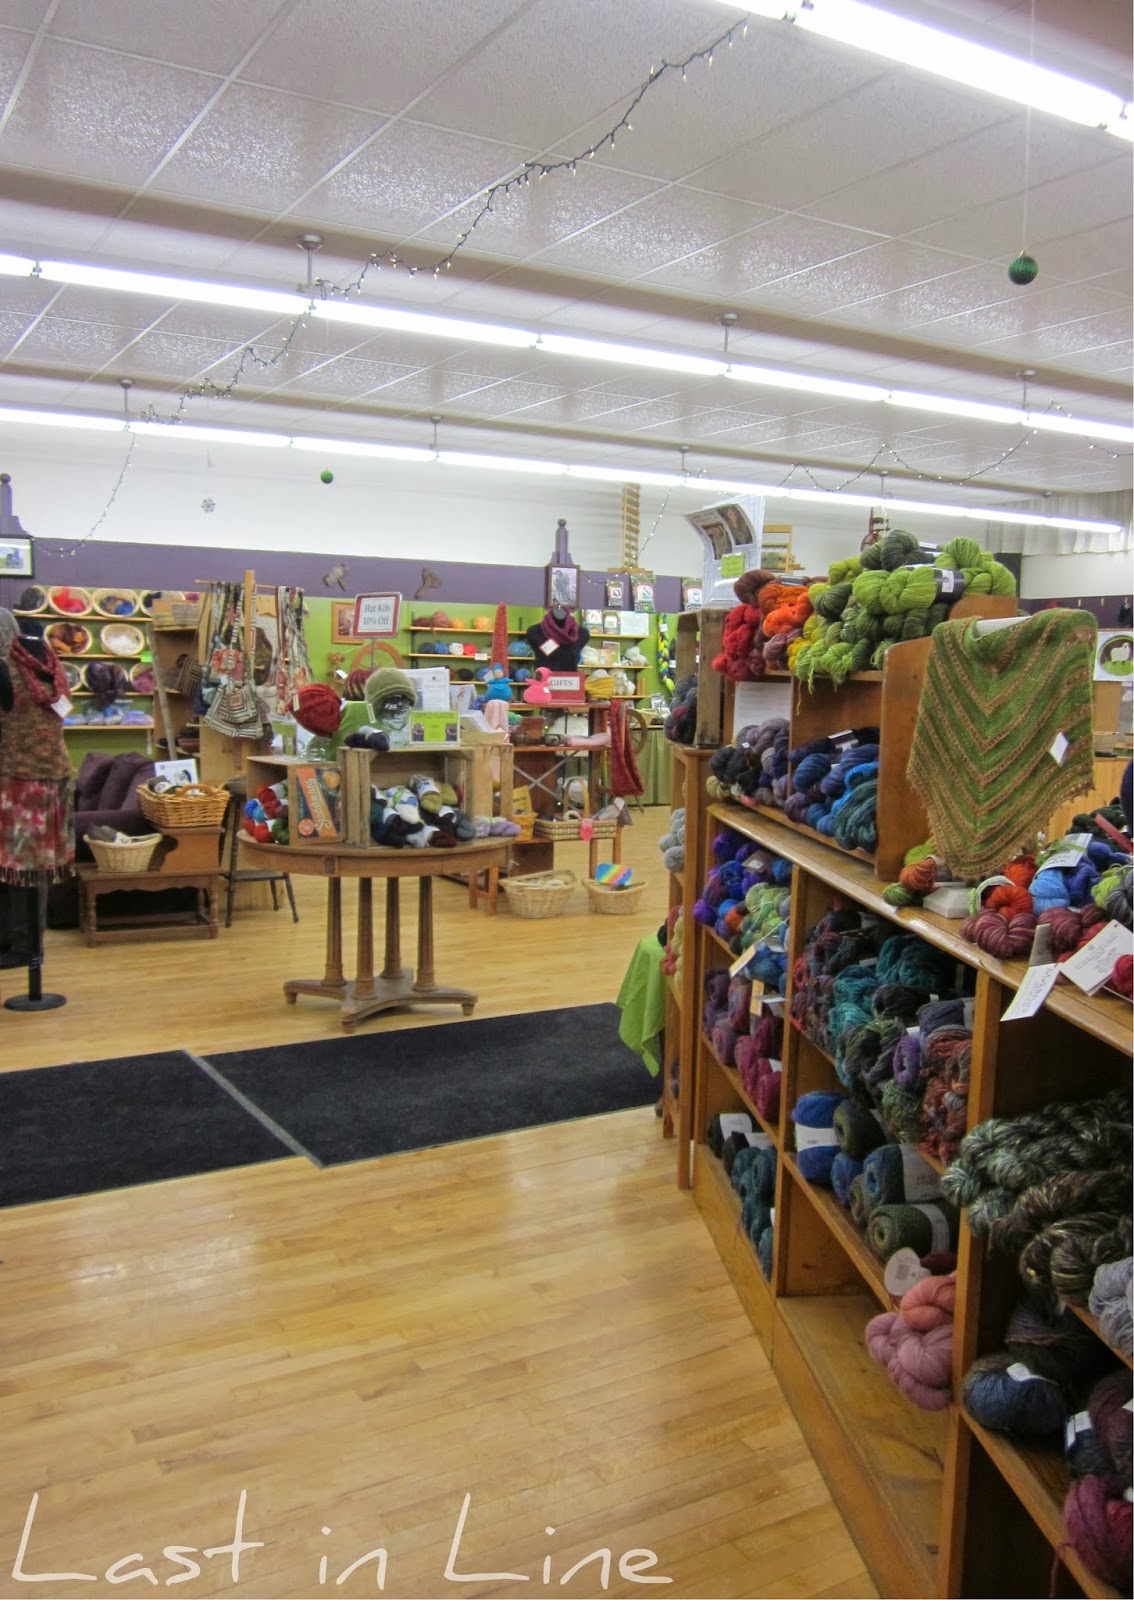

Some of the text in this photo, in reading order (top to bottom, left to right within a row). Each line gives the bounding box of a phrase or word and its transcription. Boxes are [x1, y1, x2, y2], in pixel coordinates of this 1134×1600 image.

[364, 602, 391, 613] Hat Kits
[363, 616, 390, 625] 10% Off
[550, 679, 573, 687] GIFTS
